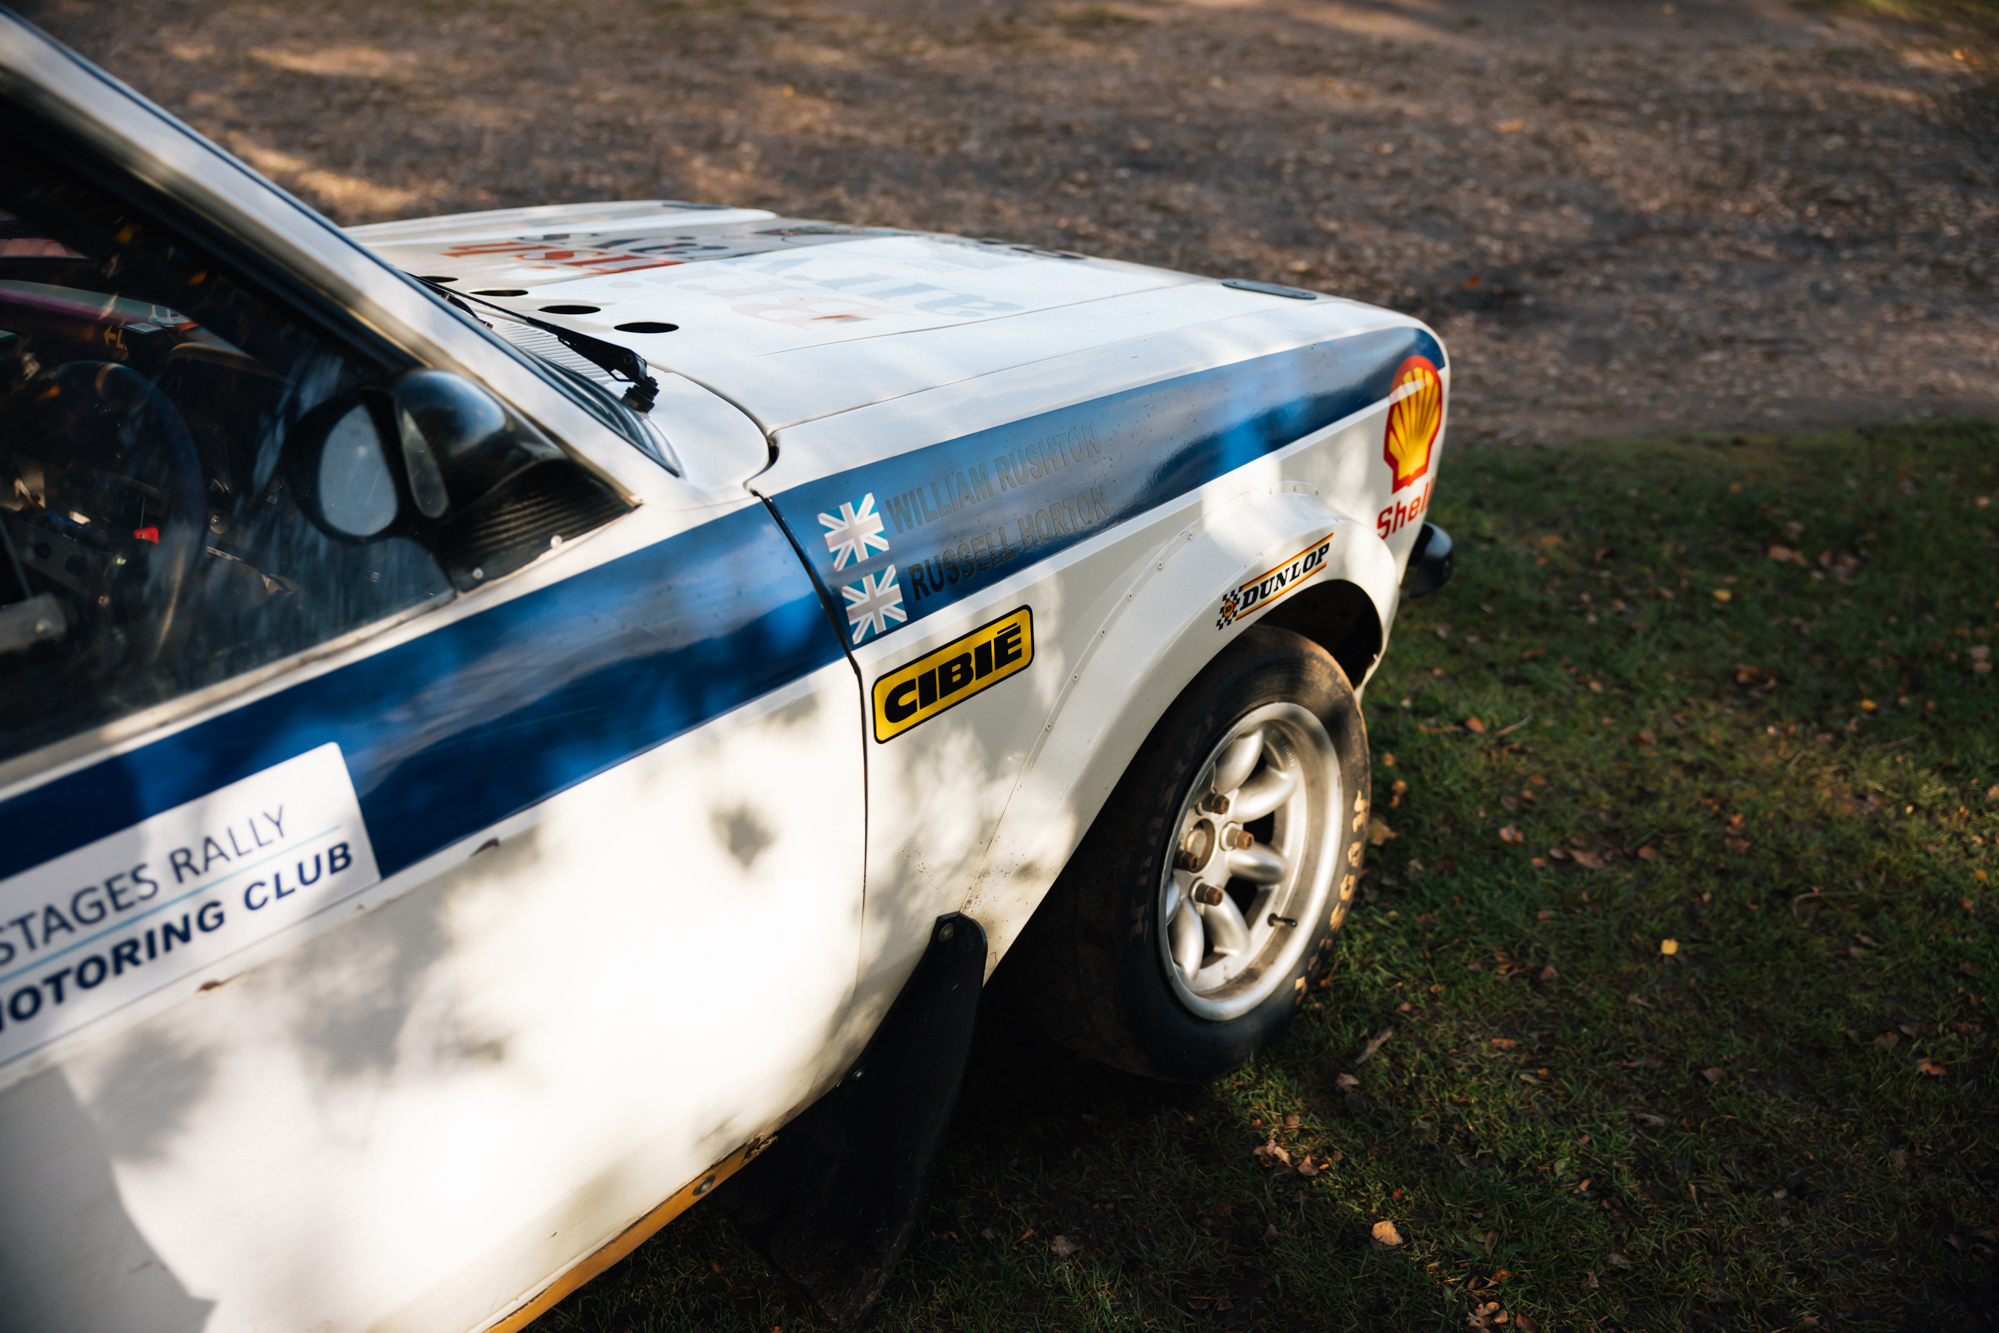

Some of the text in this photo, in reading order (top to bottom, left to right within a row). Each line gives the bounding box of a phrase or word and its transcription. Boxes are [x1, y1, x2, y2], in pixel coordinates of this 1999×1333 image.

[441, 241, 917, 331] British
[514, 231, 1025, 318] airways
[885, 422, 1102, 534] WILLIAM RUSHTON
[1377, 477, 1435, 541] Shell
[908, 483, 1110, 602] RUSSELL HORTON
[1240, 543, 1330, 611] DUNLOP
[169, 805, 285, 884] RALLY
[0, 841, 354, 1034] OTORING CLUB
